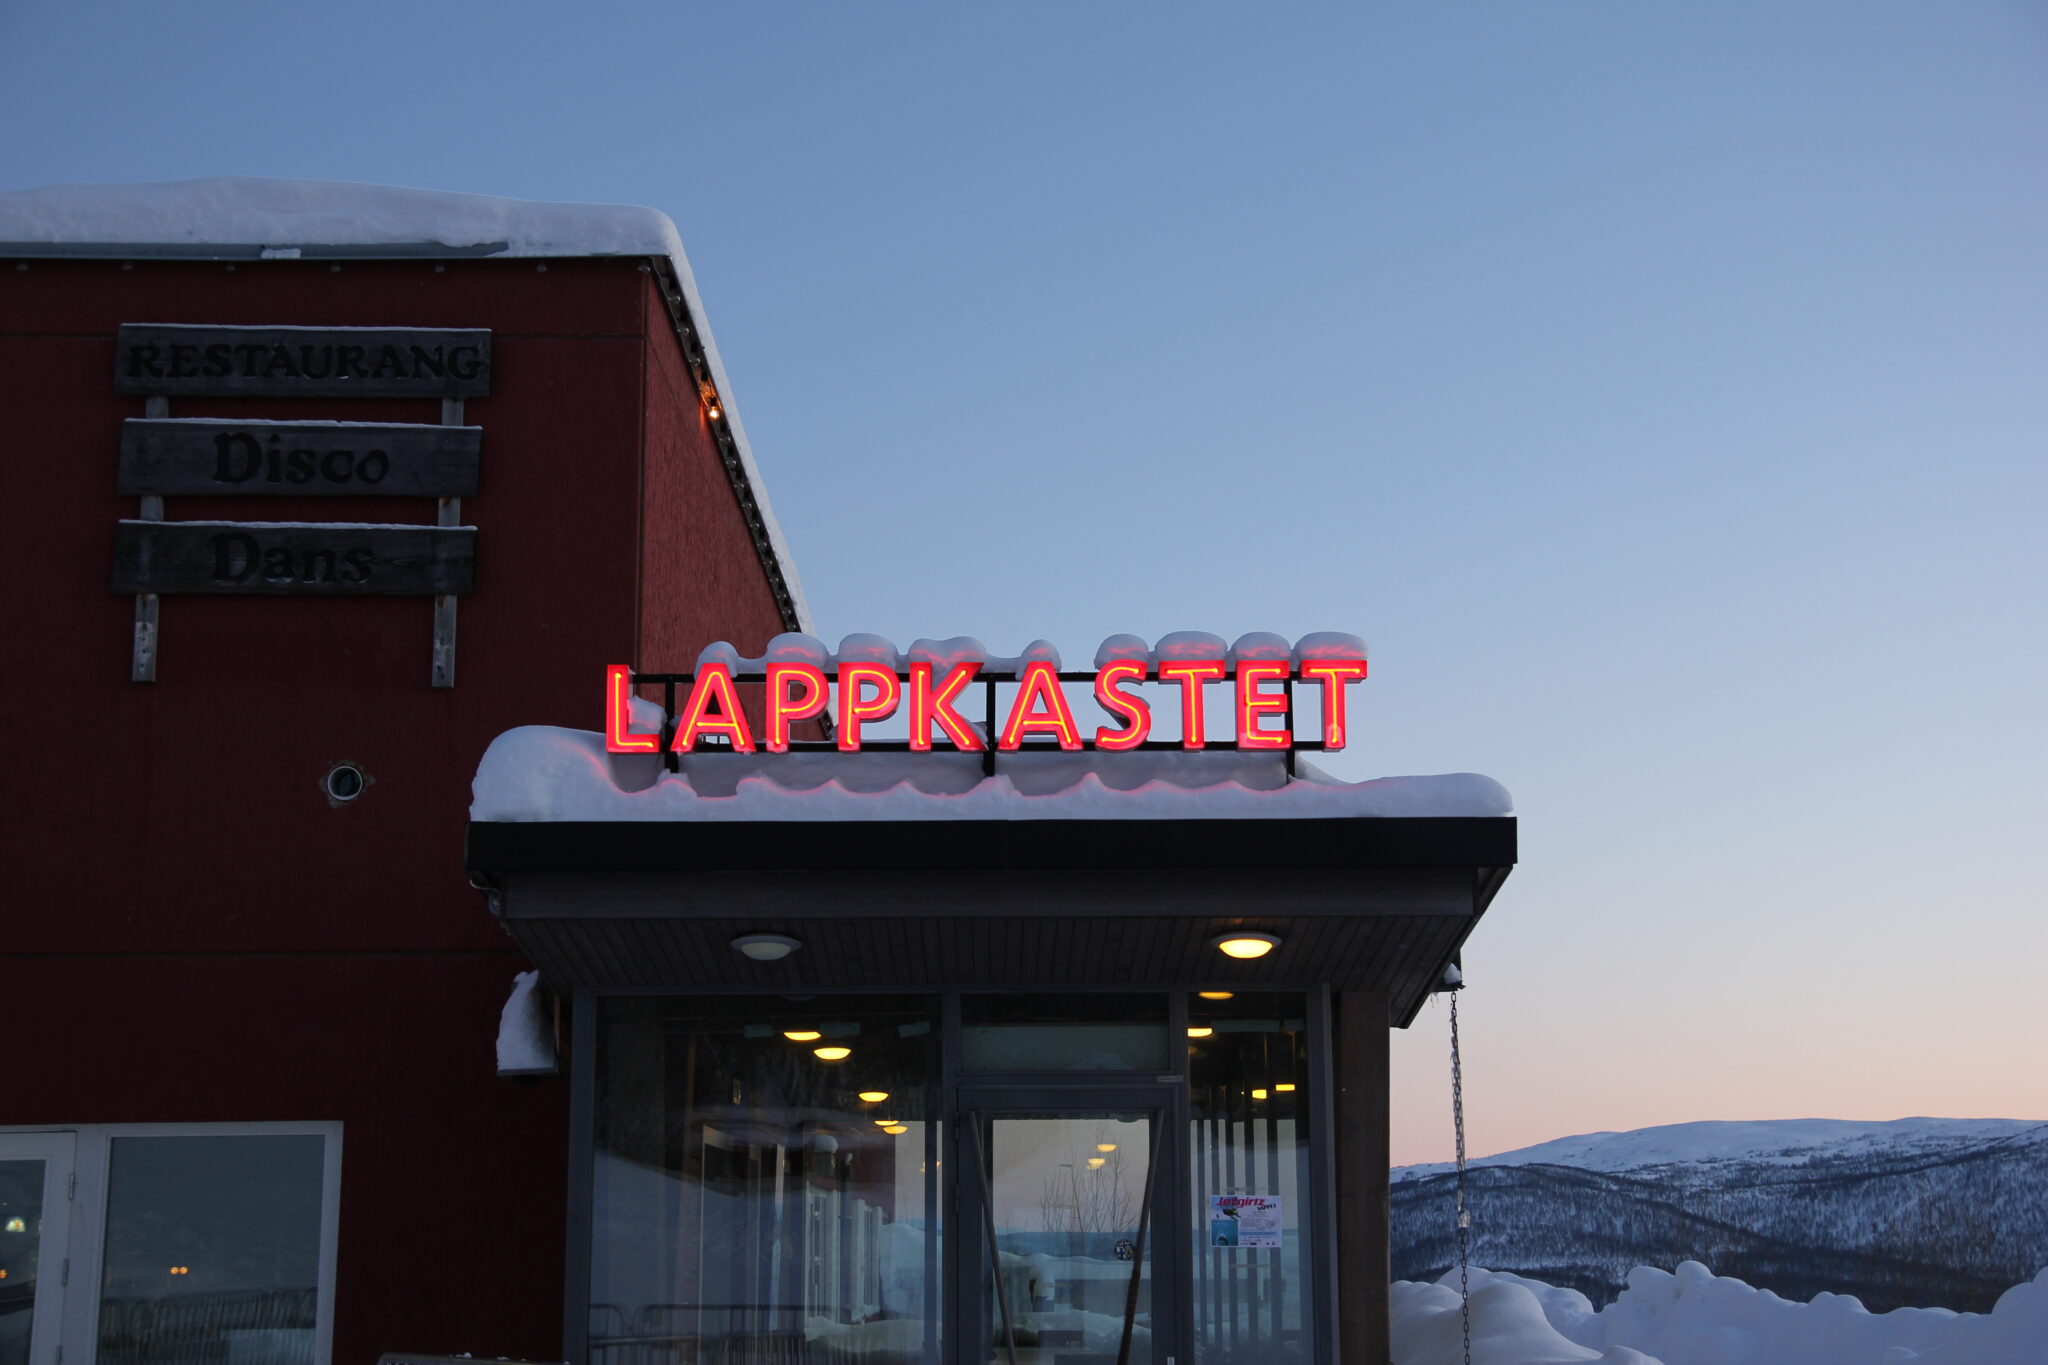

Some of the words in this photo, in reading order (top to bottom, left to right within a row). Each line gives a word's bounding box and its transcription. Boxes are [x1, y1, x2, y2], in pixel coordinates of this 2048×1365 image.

[126, 343, 483, 381] RESTAURANG
[211, 431, 390, 486] Disco
[209, 532, 377, 584] Dans
[606, 660, 1367, 753] LAPPKASTET
